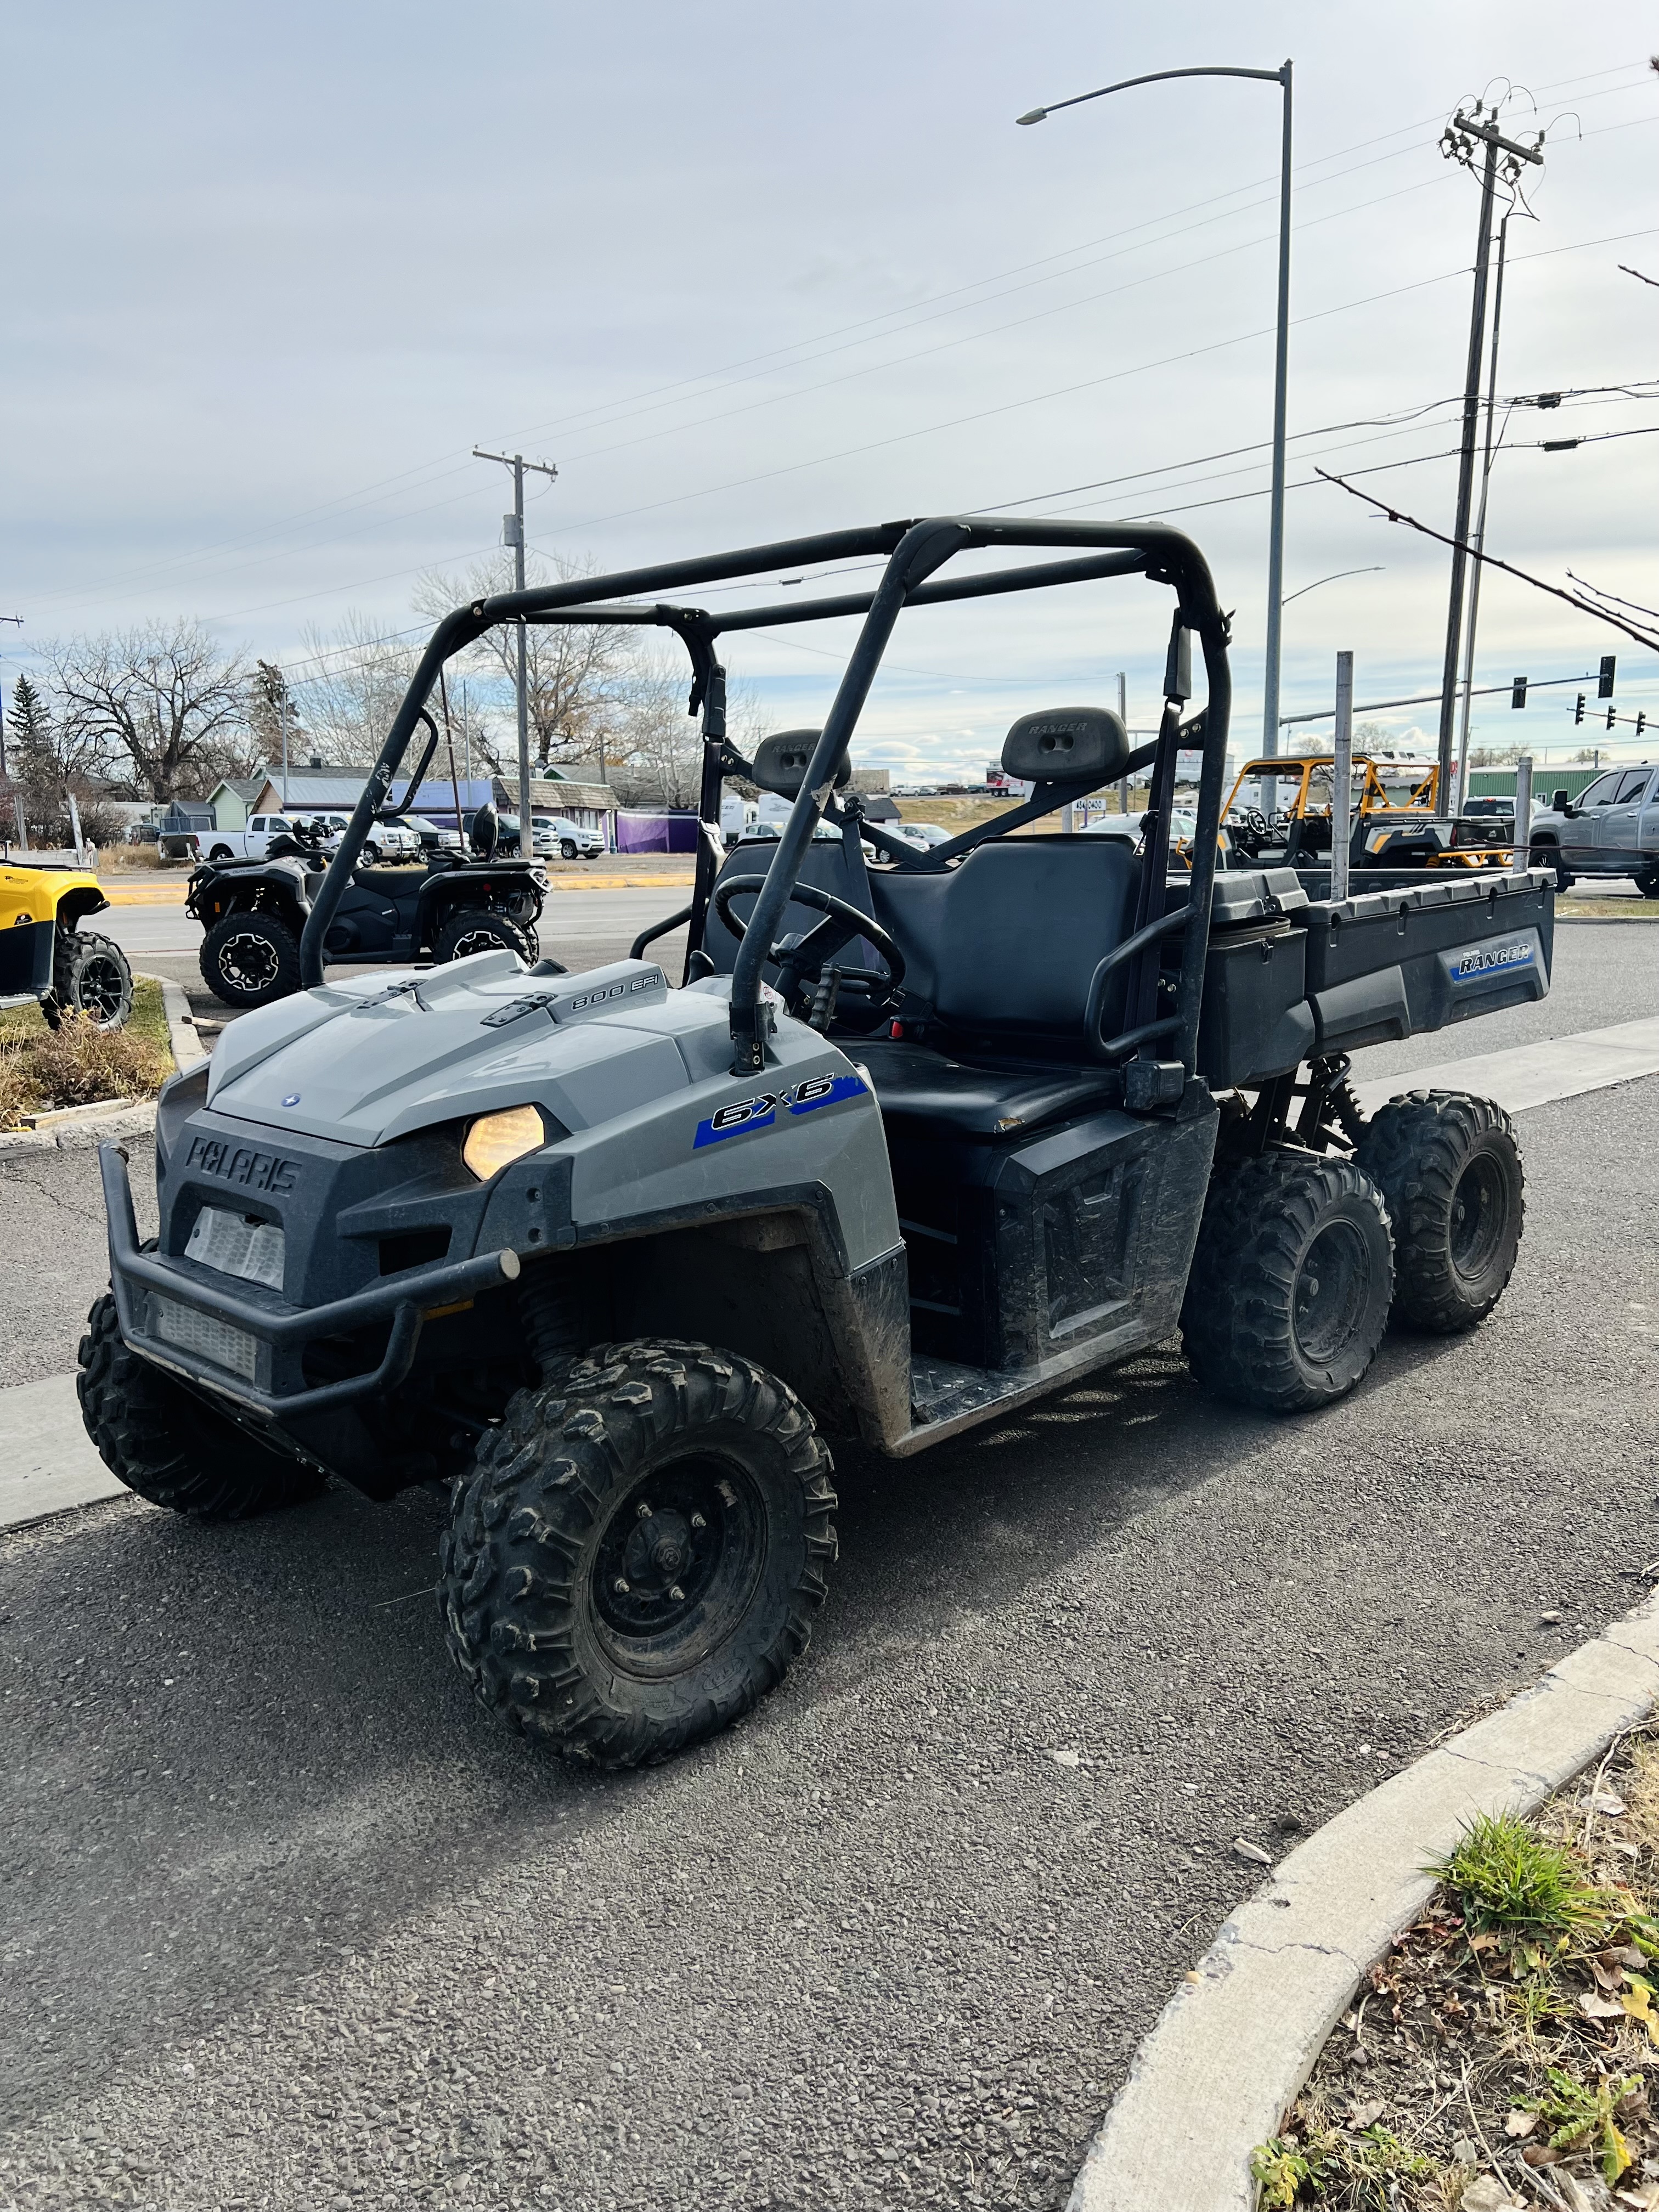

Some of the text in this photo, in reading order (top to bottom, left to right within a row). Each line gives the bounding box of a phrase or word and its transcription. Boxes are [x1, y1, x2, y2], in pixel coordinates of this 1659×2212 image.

[1028, 721, 1088, 734] RANGER
[772, 743, 816, 753] RANGER
[1459, 944, 1529, 975] RANGER
[571, 974, 658, 1011] 800 EFI
[711, 1072, 835, 1130] 6X6
[184, 1136, 302, 1198] POLARIS
